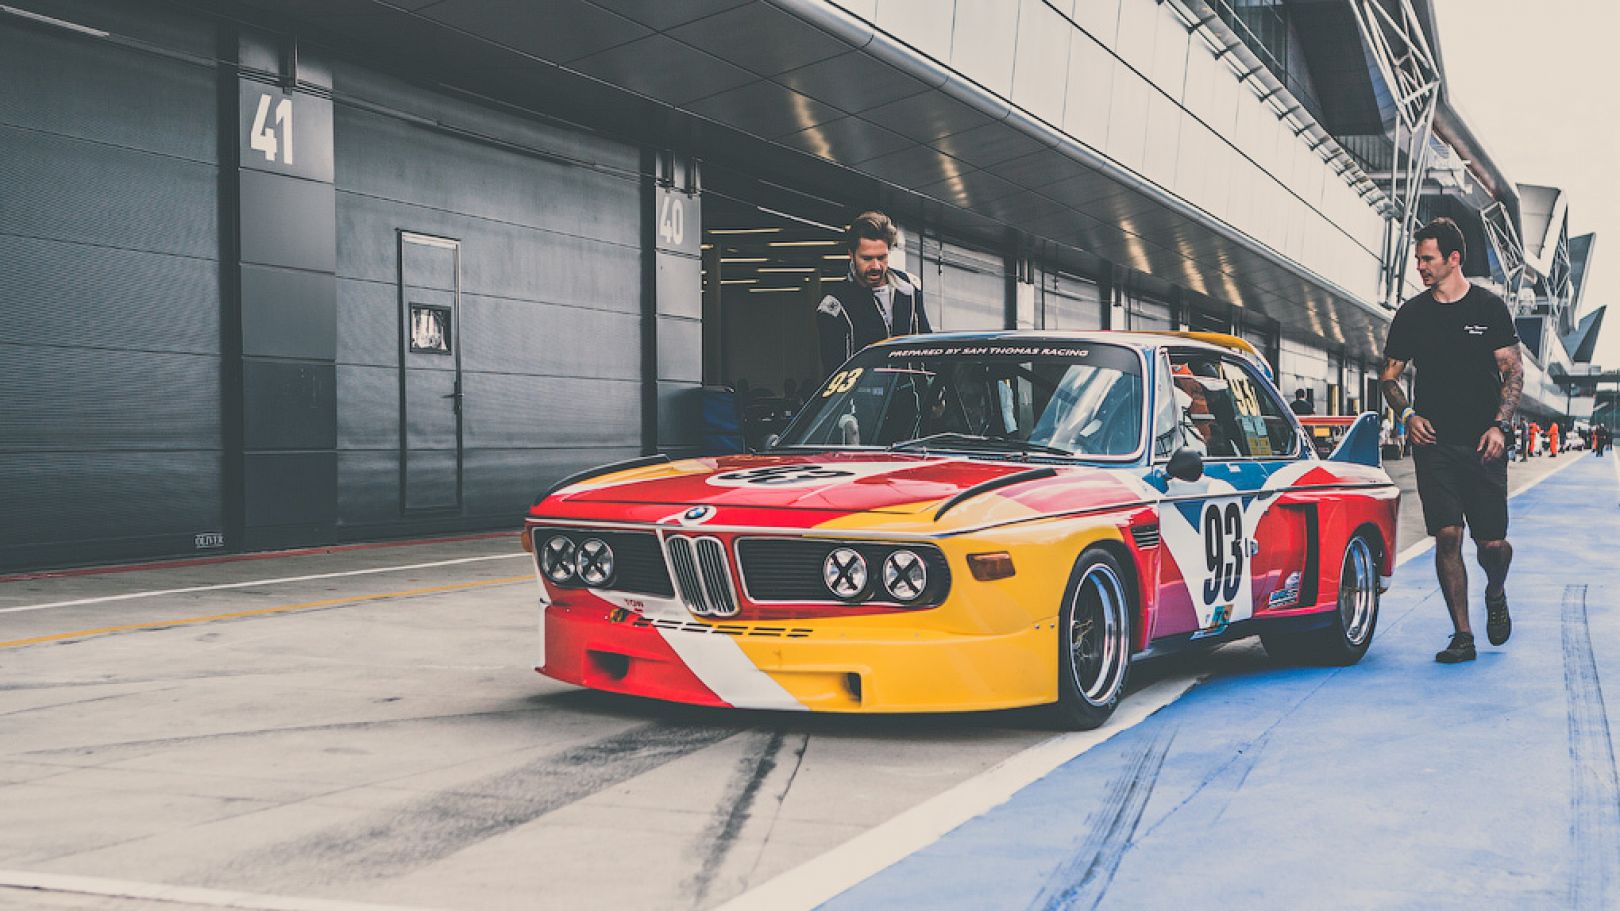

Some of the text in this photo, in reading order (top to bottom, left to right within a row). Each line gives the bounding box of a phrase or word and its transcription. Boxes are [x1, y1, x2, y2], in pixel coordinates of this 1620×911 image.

[250, 93, 293, 165] 41
[660, 196, 683, 245] 40
[888, 348, 944, 358] PREPARED
[962, 347, 988, 355] SAM
[989, 347, 1040, 355] THOMAS
[1041, 348, 1089, 357] RACING
[822, 367, 864, 398] 93
[1203, 502, 1243, 605] 93
